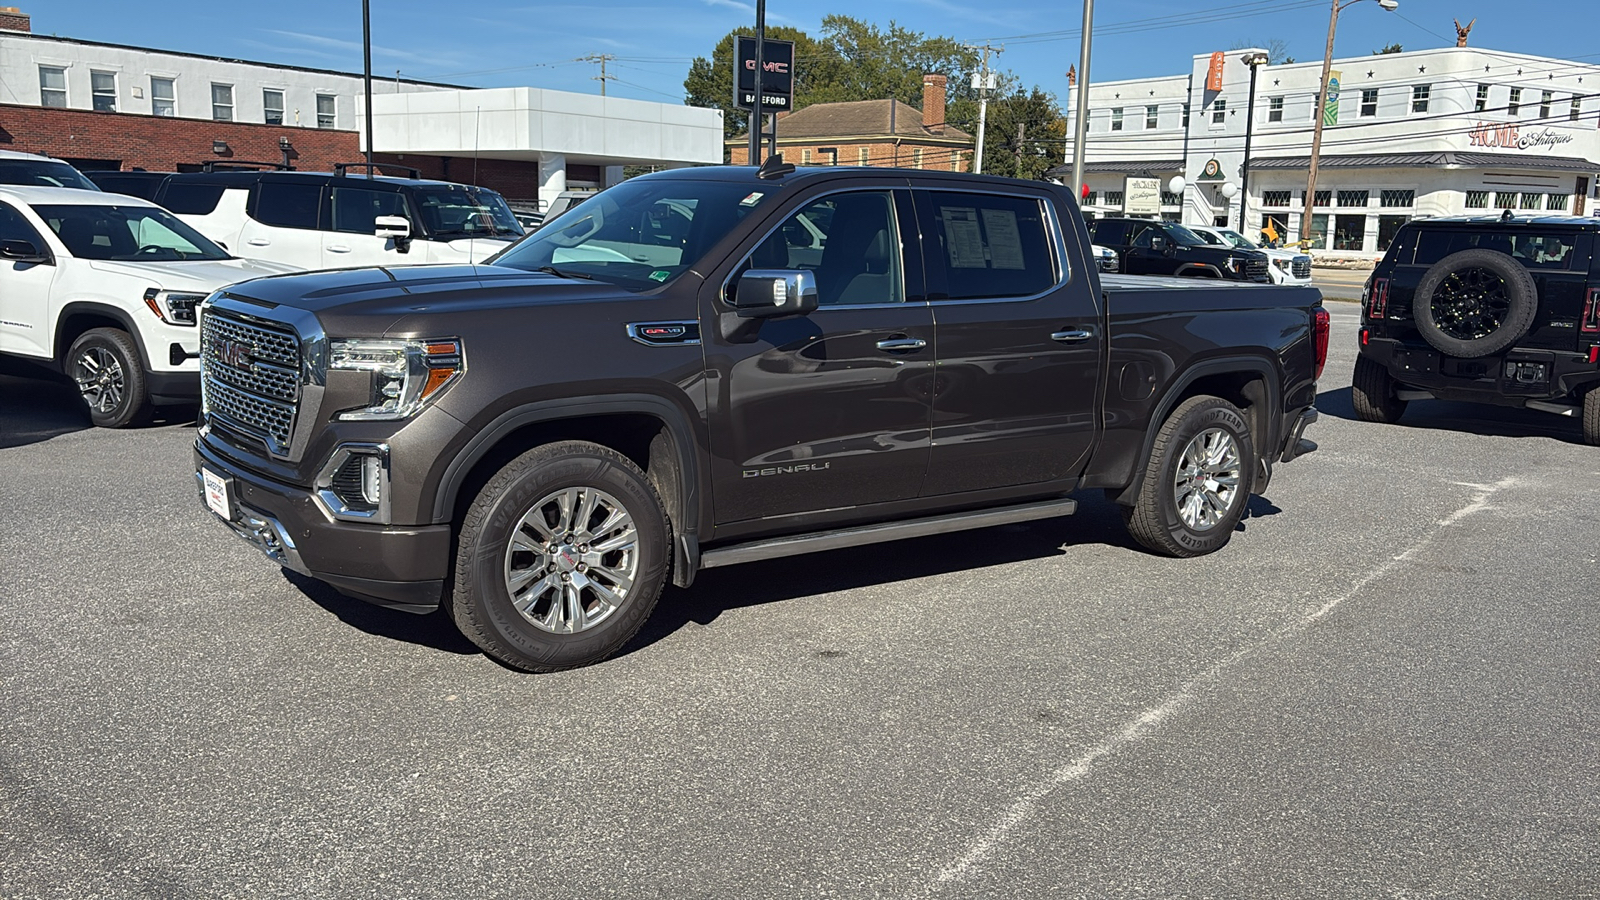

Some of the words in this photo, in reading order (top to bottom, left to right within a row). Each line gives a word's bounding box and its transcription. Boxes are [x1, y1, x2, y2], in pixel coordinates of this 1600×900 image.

[745, 59, 788, 74] GMC
[745, 94, 786, 105] BAEFORD
[1469, 122, 1520, 148] ACME
[1519, 127, 1573, 151] Antiques
[742, 461, 830, 478] DENALI
